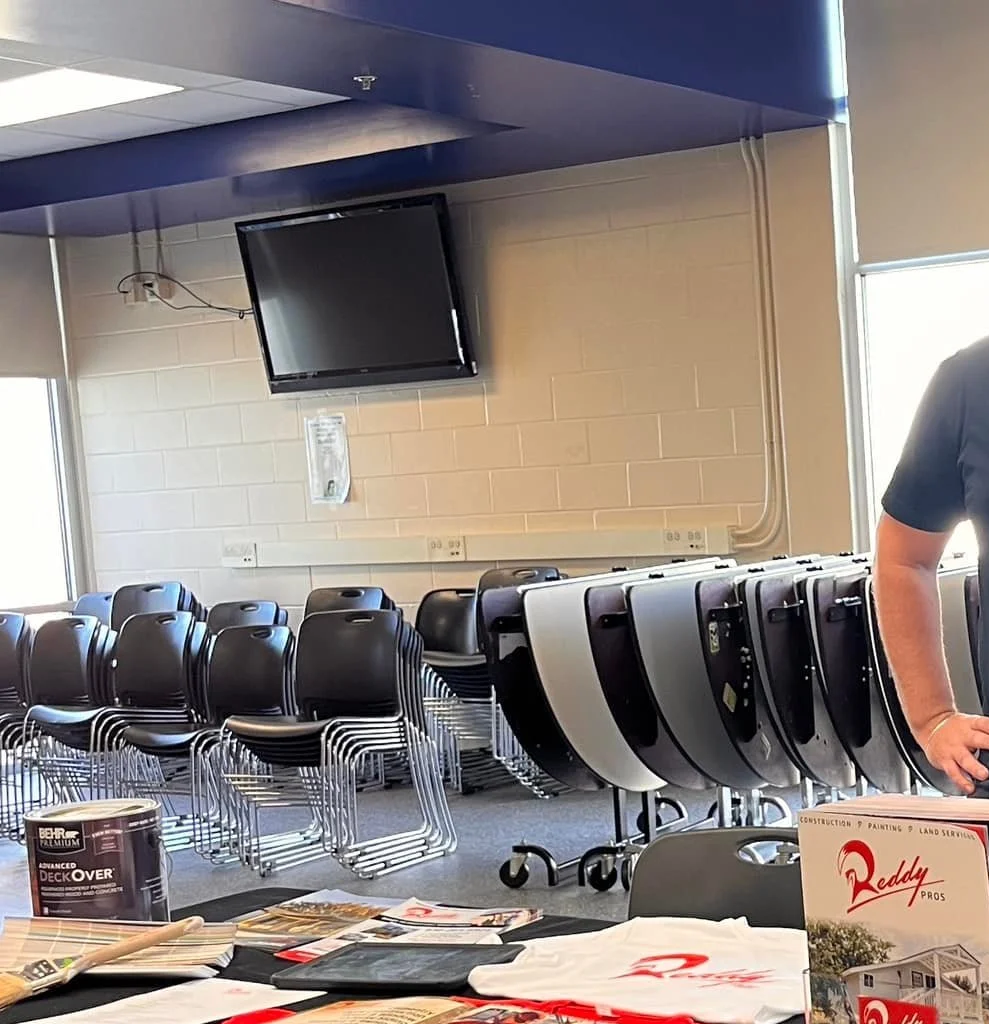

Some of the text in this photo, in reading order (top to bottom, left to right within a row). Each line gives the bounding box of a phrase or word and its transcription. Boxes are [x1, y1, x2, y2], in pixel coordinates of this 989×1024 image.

[799, 816, 852, 828] CONSTRUCTION
[867, 822, 903, 833] PAINTING
[919, 827, 940, 836] LAND
[38, 827, 66, 839] BEHR
[39, 838, 80, 848] PREMIUM
[38, 862, 77, 870] ADVANCED
[837, 839, 930, 909] Reddy
[920, 890, 946, 901] PROS
